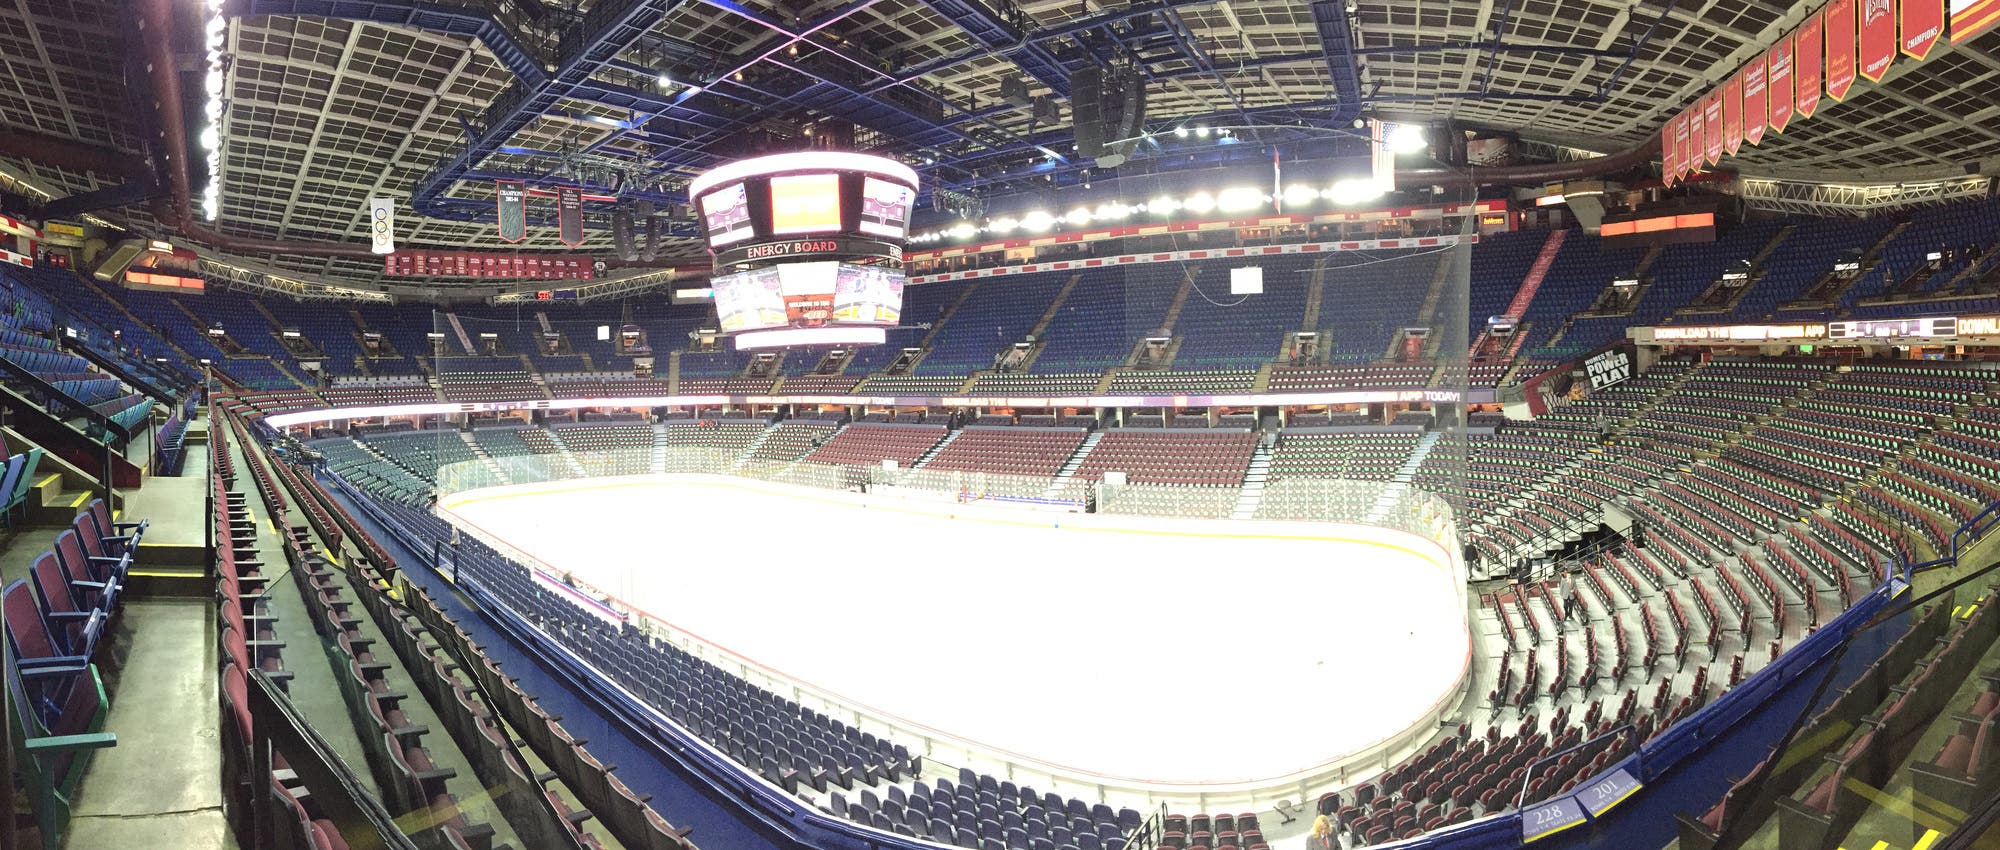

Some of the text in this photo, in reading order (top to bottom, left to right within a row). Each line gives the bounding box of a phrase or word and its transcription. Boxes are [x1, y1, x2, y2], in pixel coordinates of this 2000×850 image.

[1907, 26, 1938, 50] CHAMPIONS
[1866, 54, 1890, 73] CHAMPIONS
[747, 241, 837, 258] ENERGY BOARD
[1654, 328, 1708, 339] DOWNLOAD
[1708, 327, 1730, 338] THE
[1804, 325, 1826, 337] APP
[1958, 318, 2000, 335] DOWNL
[1586, 353, 1629, 377] POWER
[1590, 364, 1630, 388] PLAY
[1400, 390, 1423, 401] APP
[1425, 390, 1460, 402] TODAY!
[1593, 780, 1619, 800] 201
[1533, 804, 1563, 825] 228
